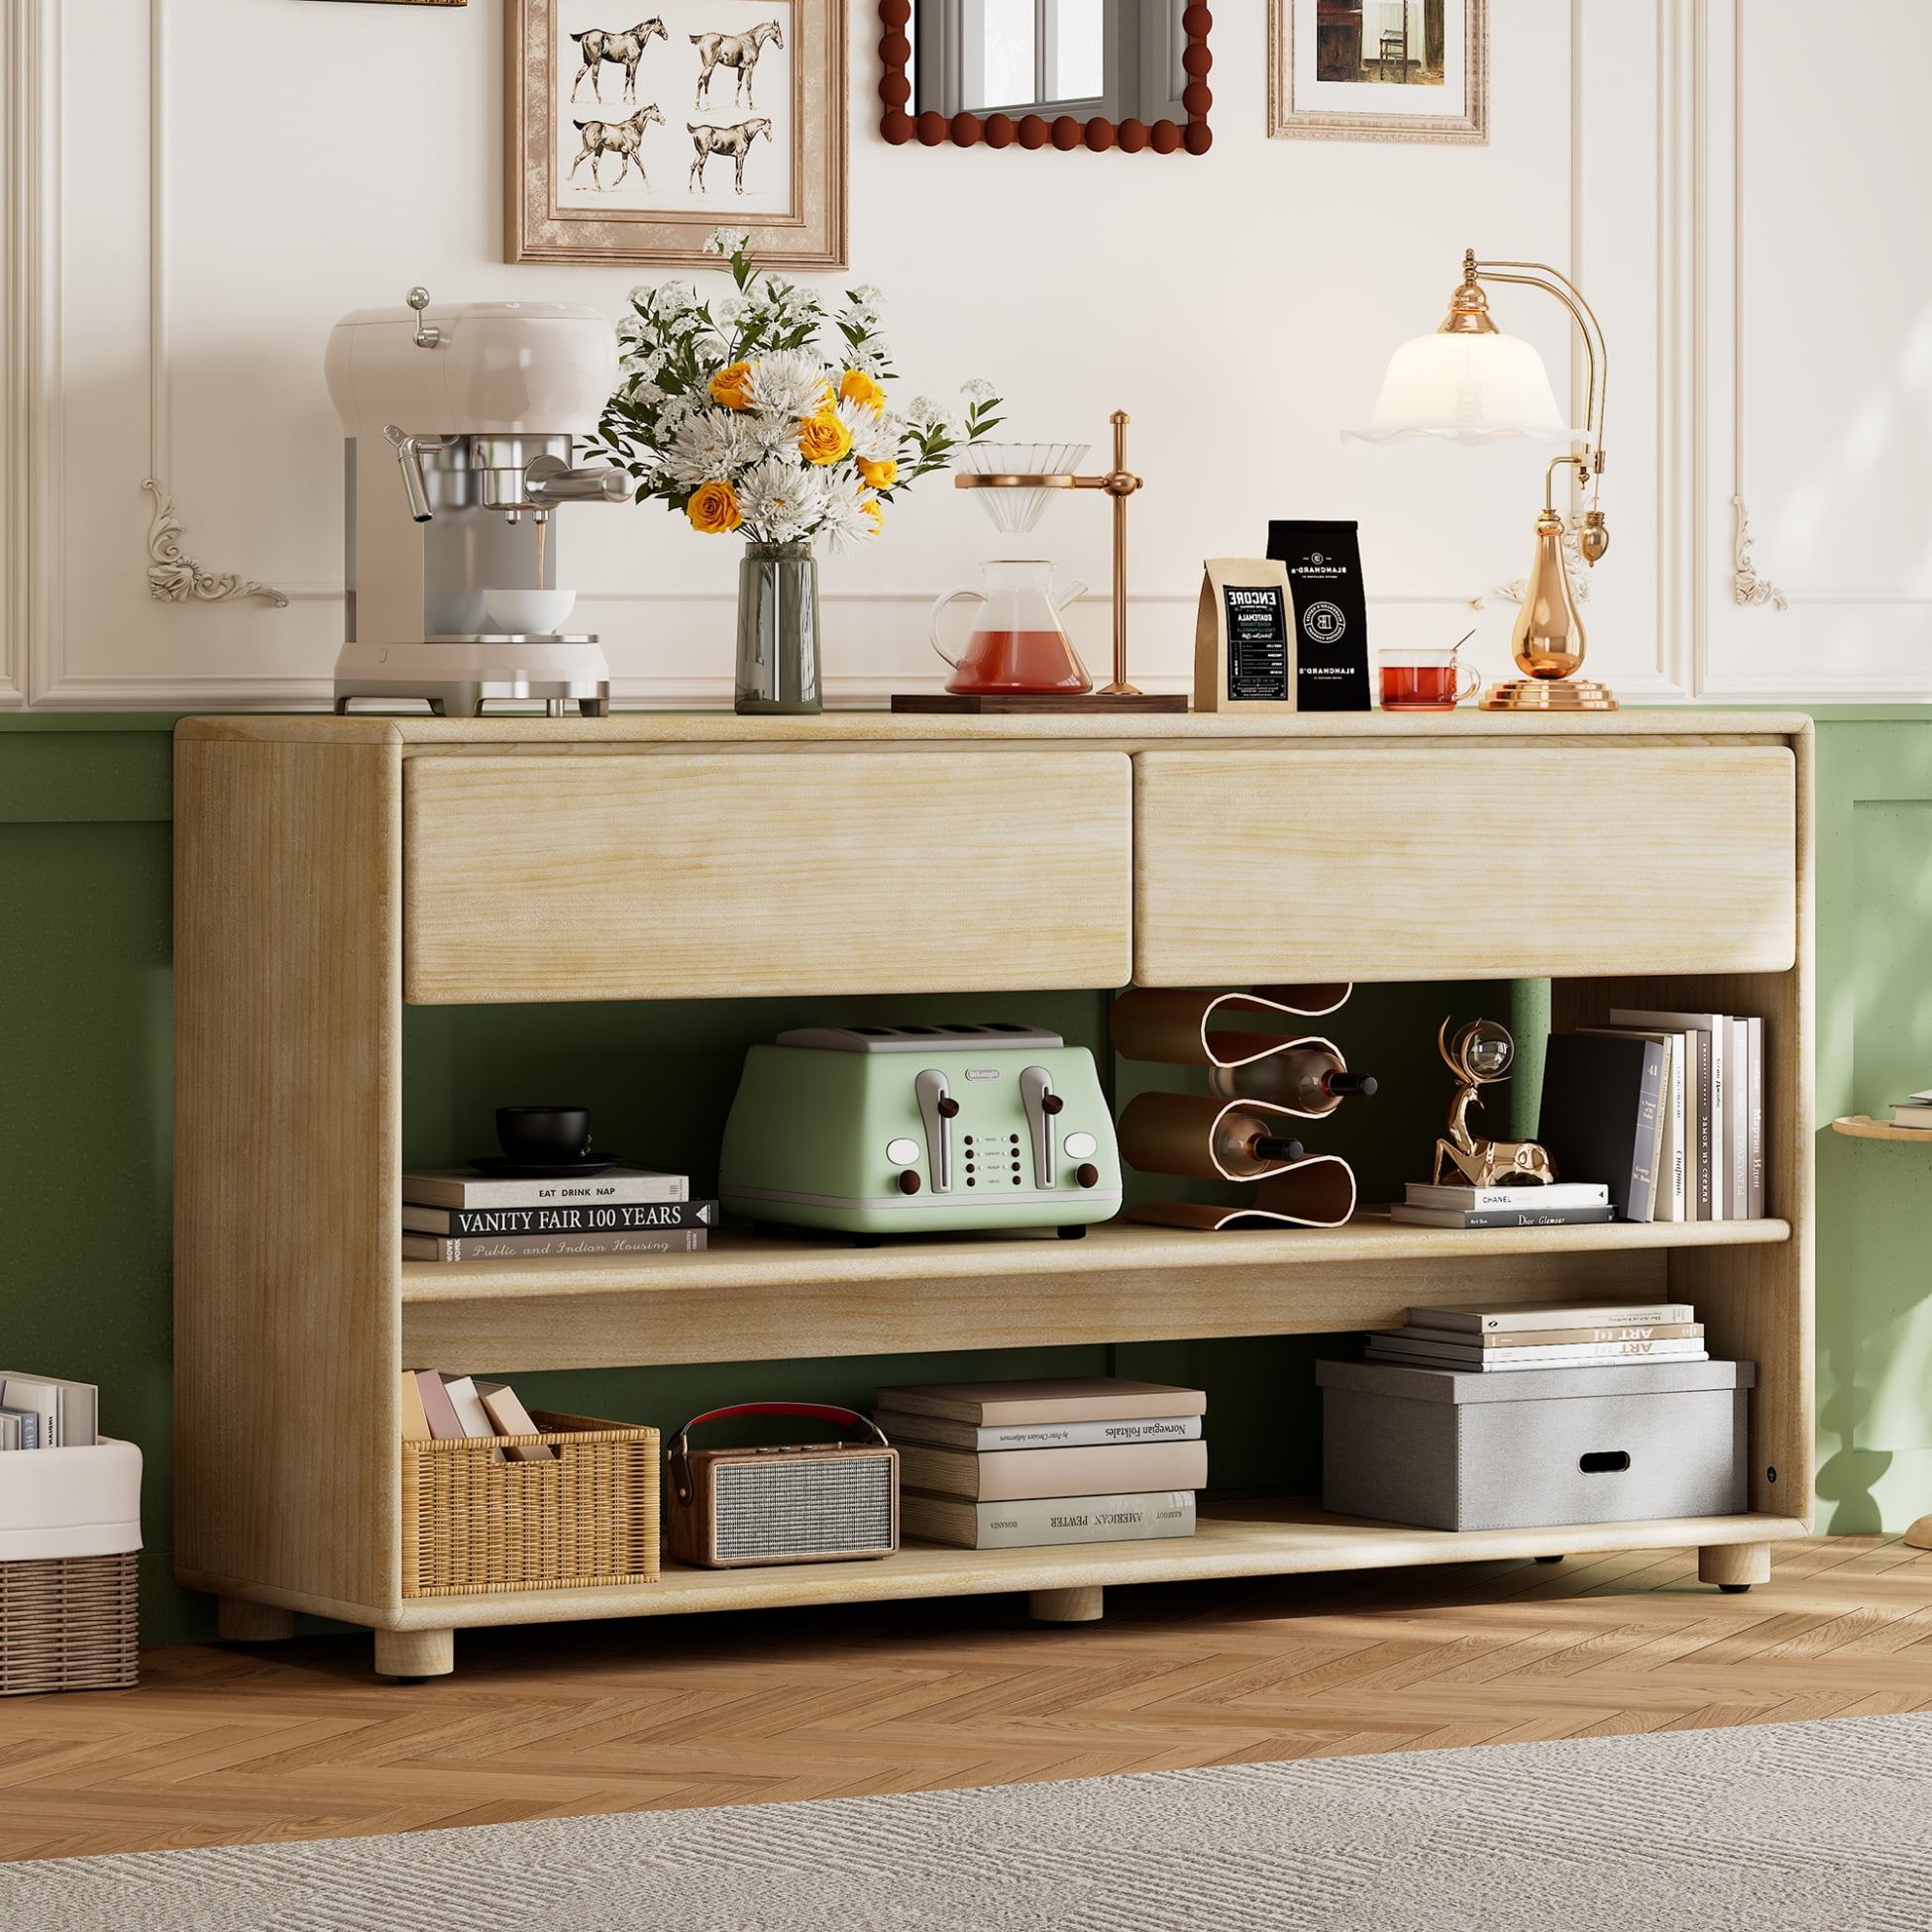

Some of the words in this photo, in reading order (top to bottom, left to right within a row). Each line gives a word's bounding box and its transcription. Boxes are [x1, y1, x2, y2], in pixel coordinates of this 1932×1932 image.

[1752, 1109, 1762, 1153] Мартин
[1752, 1158, 1762, 1188] Иден
[539, 1189, 557, 1198] EAT
[562, 1188, 590, 1197] DRINK
[459, 1211, 533, 1233] VANITY
[539, 1210, 581, 1230] FAIR
[588, 1209, 616, 1228] 100
[622, 1206, 682, 1226] YEARS
[1518, 1215, 1535, 1226] Dior
[473, 1244, 516, 1257] Public
[523, 1243, 550, 1254] and
[557, 1241, 606, 1254] Indian
[612, 1239, 670, 1252] Housing
[1619, 1328, 1653, 1340] ART
[1620, 1342, 1653, 1353] ART
[1105, 1427, 1141, 1440] Folktales
[1142, 1422, 1186, 1436] Norwegian
[1050, 1515, 1089, 1528] PEWTER
[1095, 1512, 1143, 1526] AMERICAN
